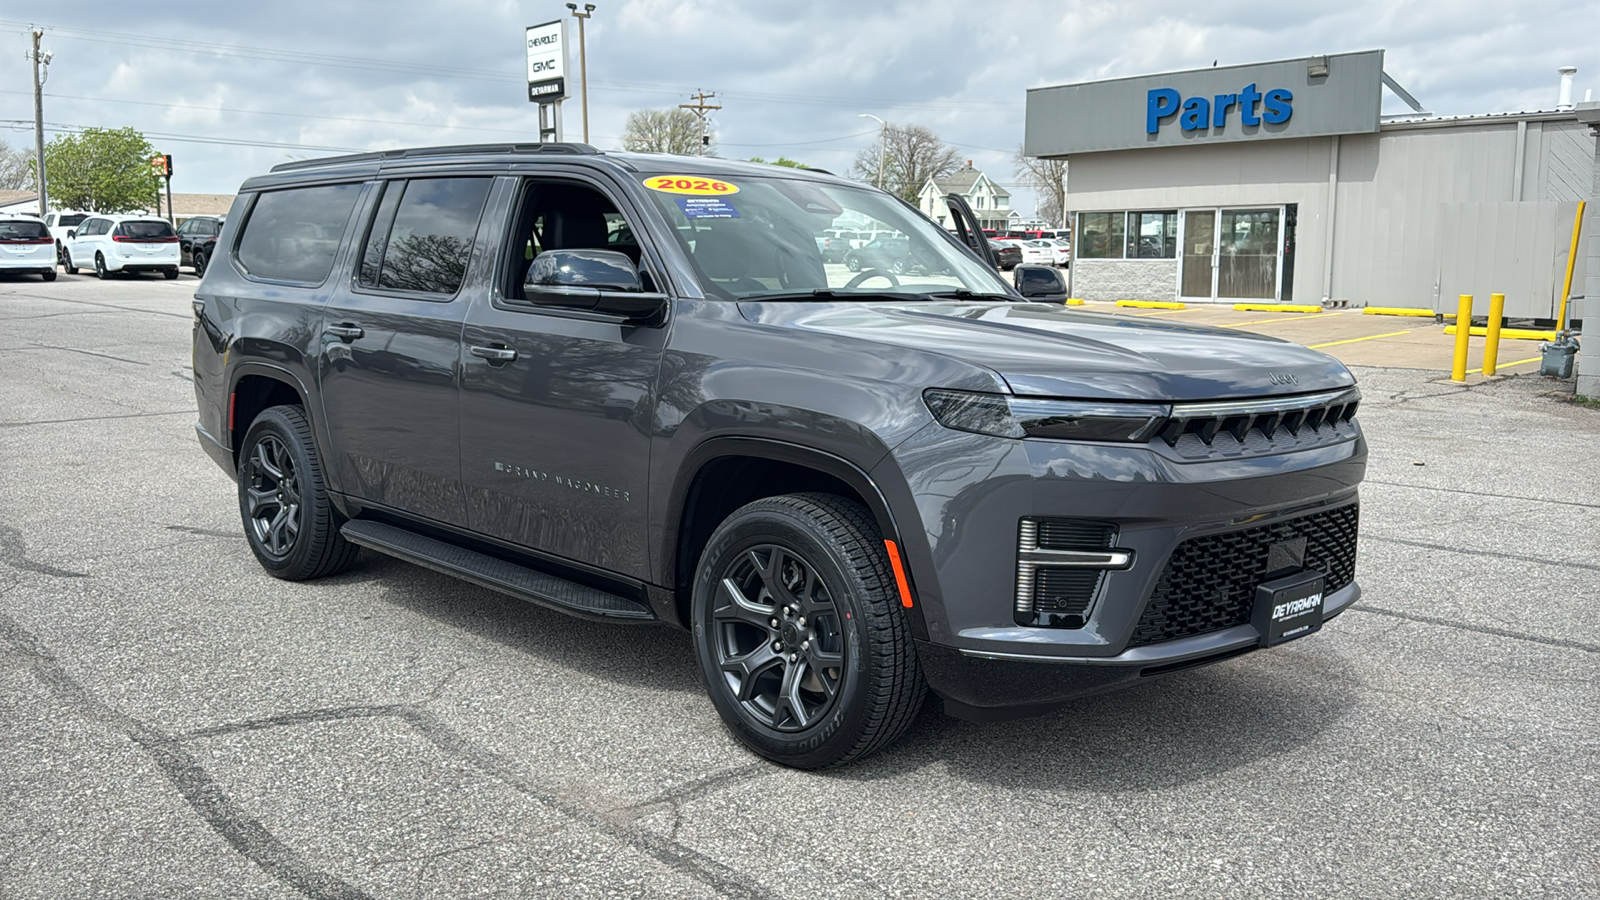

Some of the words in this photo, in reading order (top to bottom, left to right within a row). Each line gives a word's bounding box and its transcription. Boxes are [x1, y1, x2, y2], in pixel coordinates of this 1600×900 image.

[528, 34, 558, 48] CHEVROLET
[533, 59, 555, 72] GMC
[1146, 83, 1293, 134] Parts
[657, 179, 729, 192] 2026
[1268, 371, 1298, 387] Jeep
[506, 464, 547, 481] GRAND
[555, 475, 630, 502] WAGONEER
[1271, 592, 1323, 620] DEYARMAN
